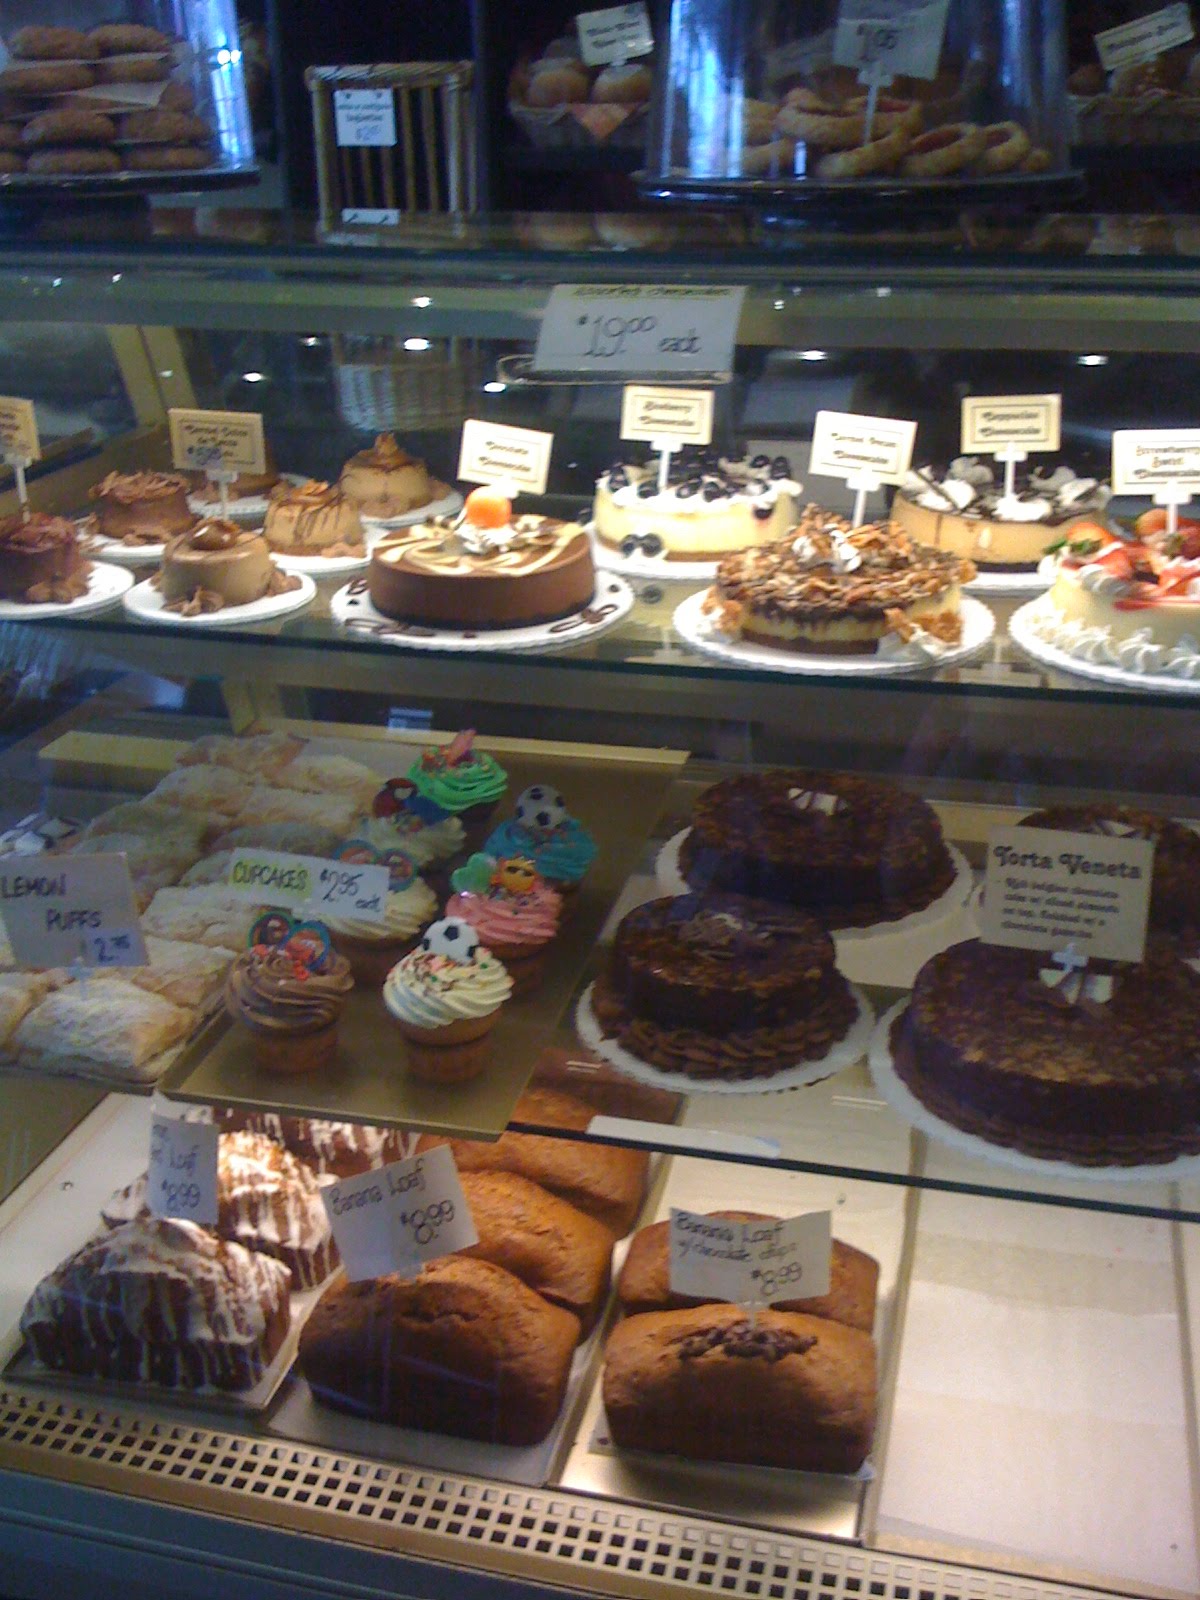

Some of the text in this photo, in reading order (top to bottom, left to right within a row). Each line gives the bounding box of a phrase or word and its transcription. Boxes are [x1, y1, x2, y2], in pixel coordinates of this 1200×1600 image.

[993, 845, 1143, 880] Torta Veneta
[1, 873, 67, 899] LEMON
[329, 1185, 384, 1216] Banana
